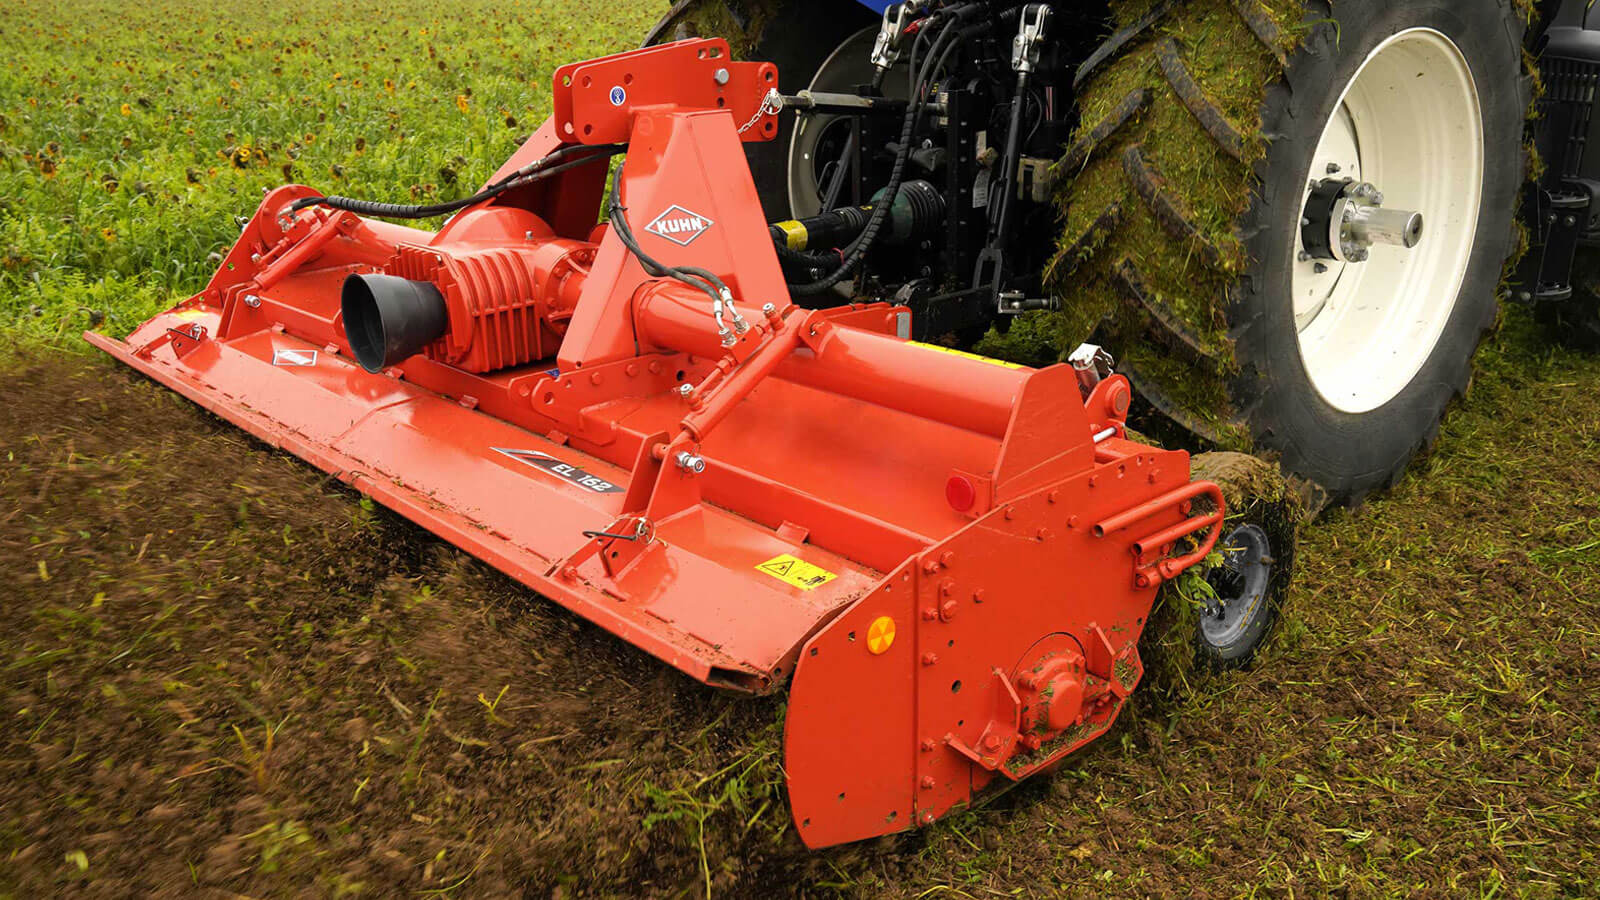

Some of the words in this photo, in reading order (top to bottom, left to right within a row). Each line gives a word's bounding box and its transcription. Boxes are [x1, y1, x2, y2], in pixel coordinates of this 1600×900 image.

[656, 217, 702, 234] KUHN
[551, 463, 576, 477] EL
[577, 474, 613, 491] 162
